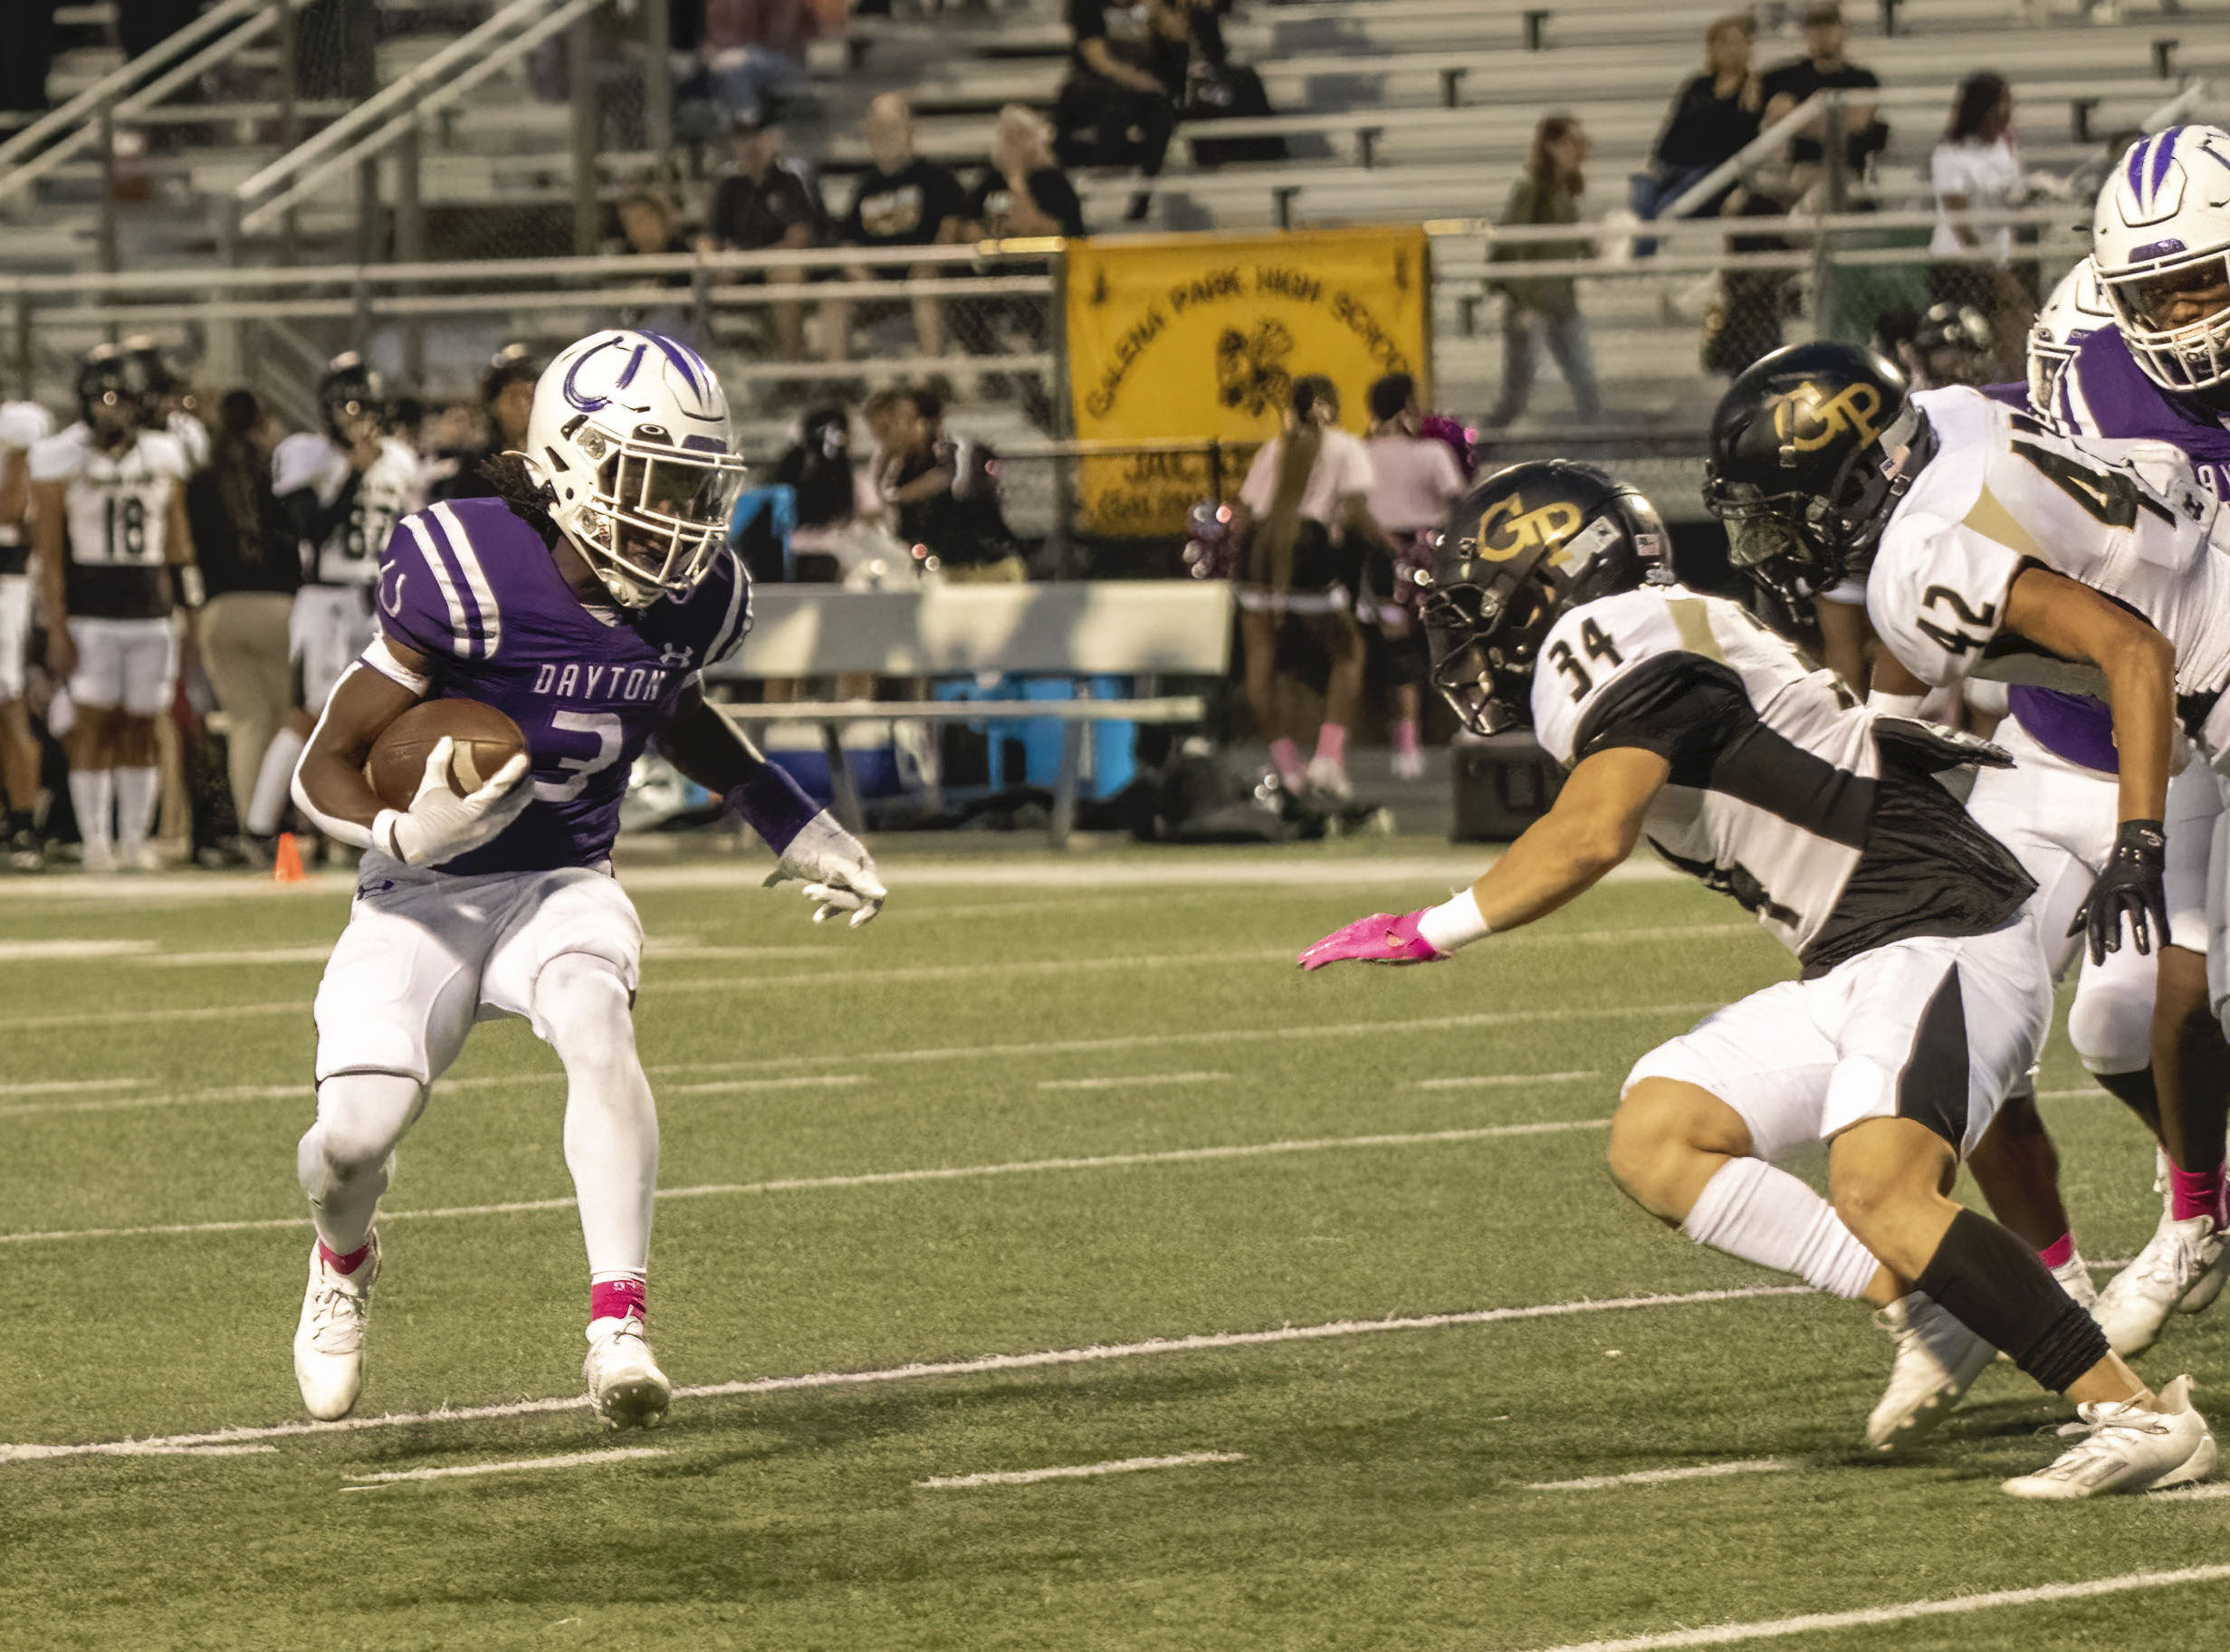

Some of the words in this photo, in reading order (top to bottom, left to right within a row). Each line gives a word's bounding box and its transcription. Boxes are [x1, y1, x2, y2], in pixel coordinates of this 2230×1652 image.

[1086, 304, 1166, 419] GALENA
[1170, 268, 1242, 313] PARK
[1256, 266, 1321, 302] HIGH
[1330, 290, 1410, 374] SCHOO
[1774, 381, 1881, 451] GP
[105, 495, 145, 555] 18
[1478, 492, 1582, 567] GP
[1917, 585, 1996, 655] 42
[532, 663, 665, 702] DAYTON
[1547, 616, 1624, 703] 34
[533, 710, 624, 802] 3
